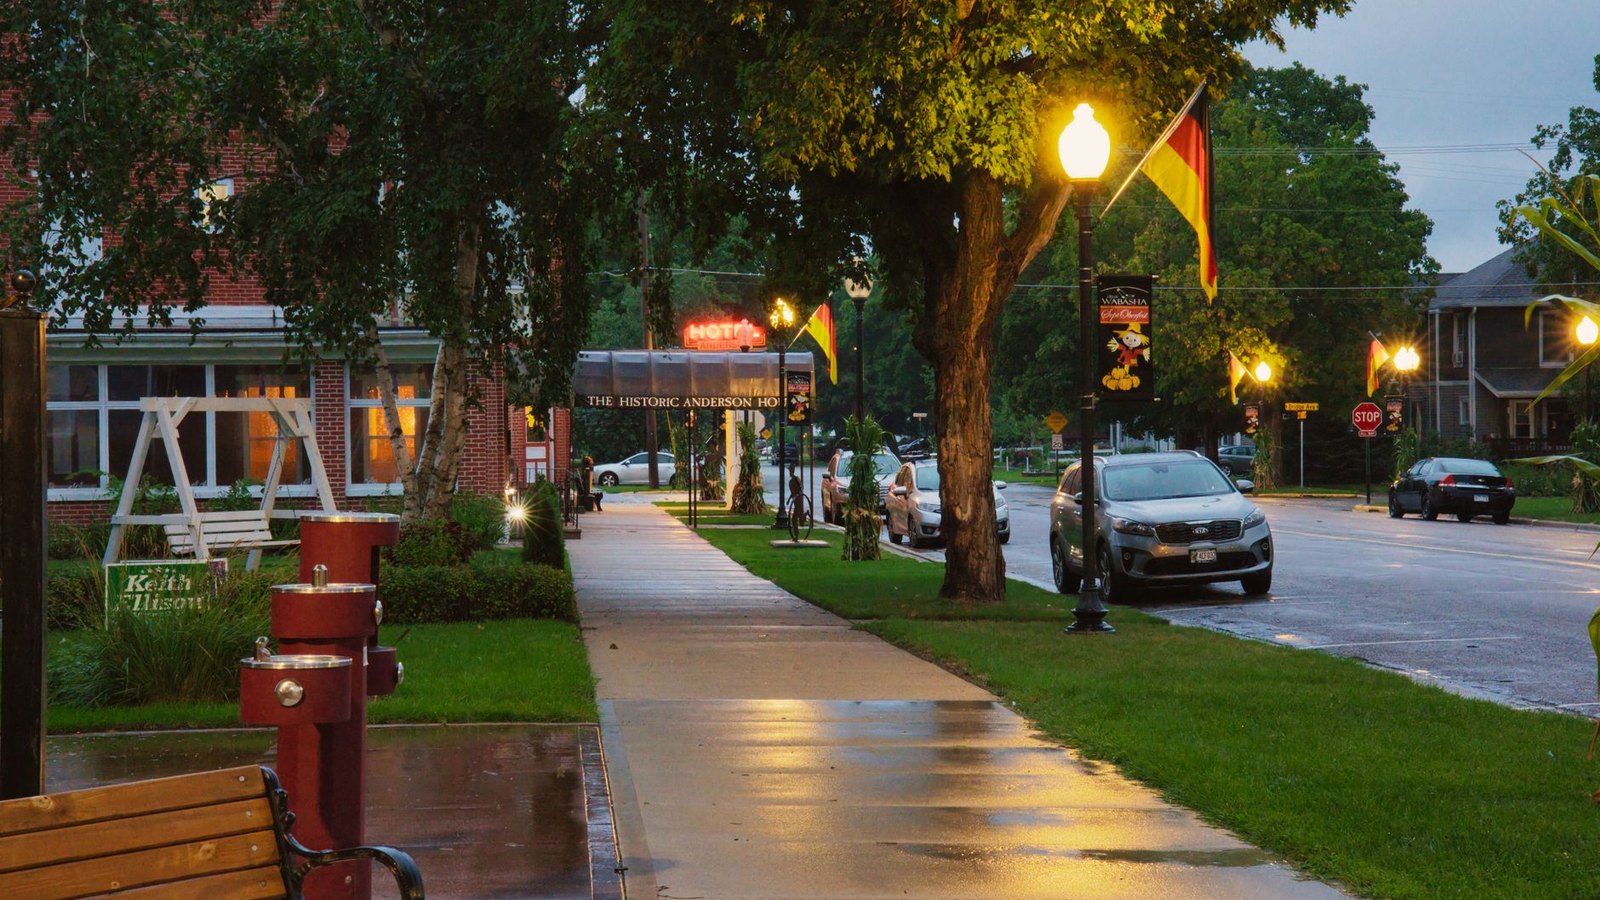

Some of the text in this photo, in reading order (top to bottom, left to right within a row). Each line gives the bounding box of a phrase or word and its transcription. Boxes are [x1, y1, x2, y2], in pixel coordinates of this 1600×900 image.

[587, 396, 613, 406] THE
[620, 397, 680, 407] HISTORIC
[683, 397, 752, 407] ANDERSON
[1354, 411, 1380, 422] STOP
[125, 574, 191, 592] Keith
